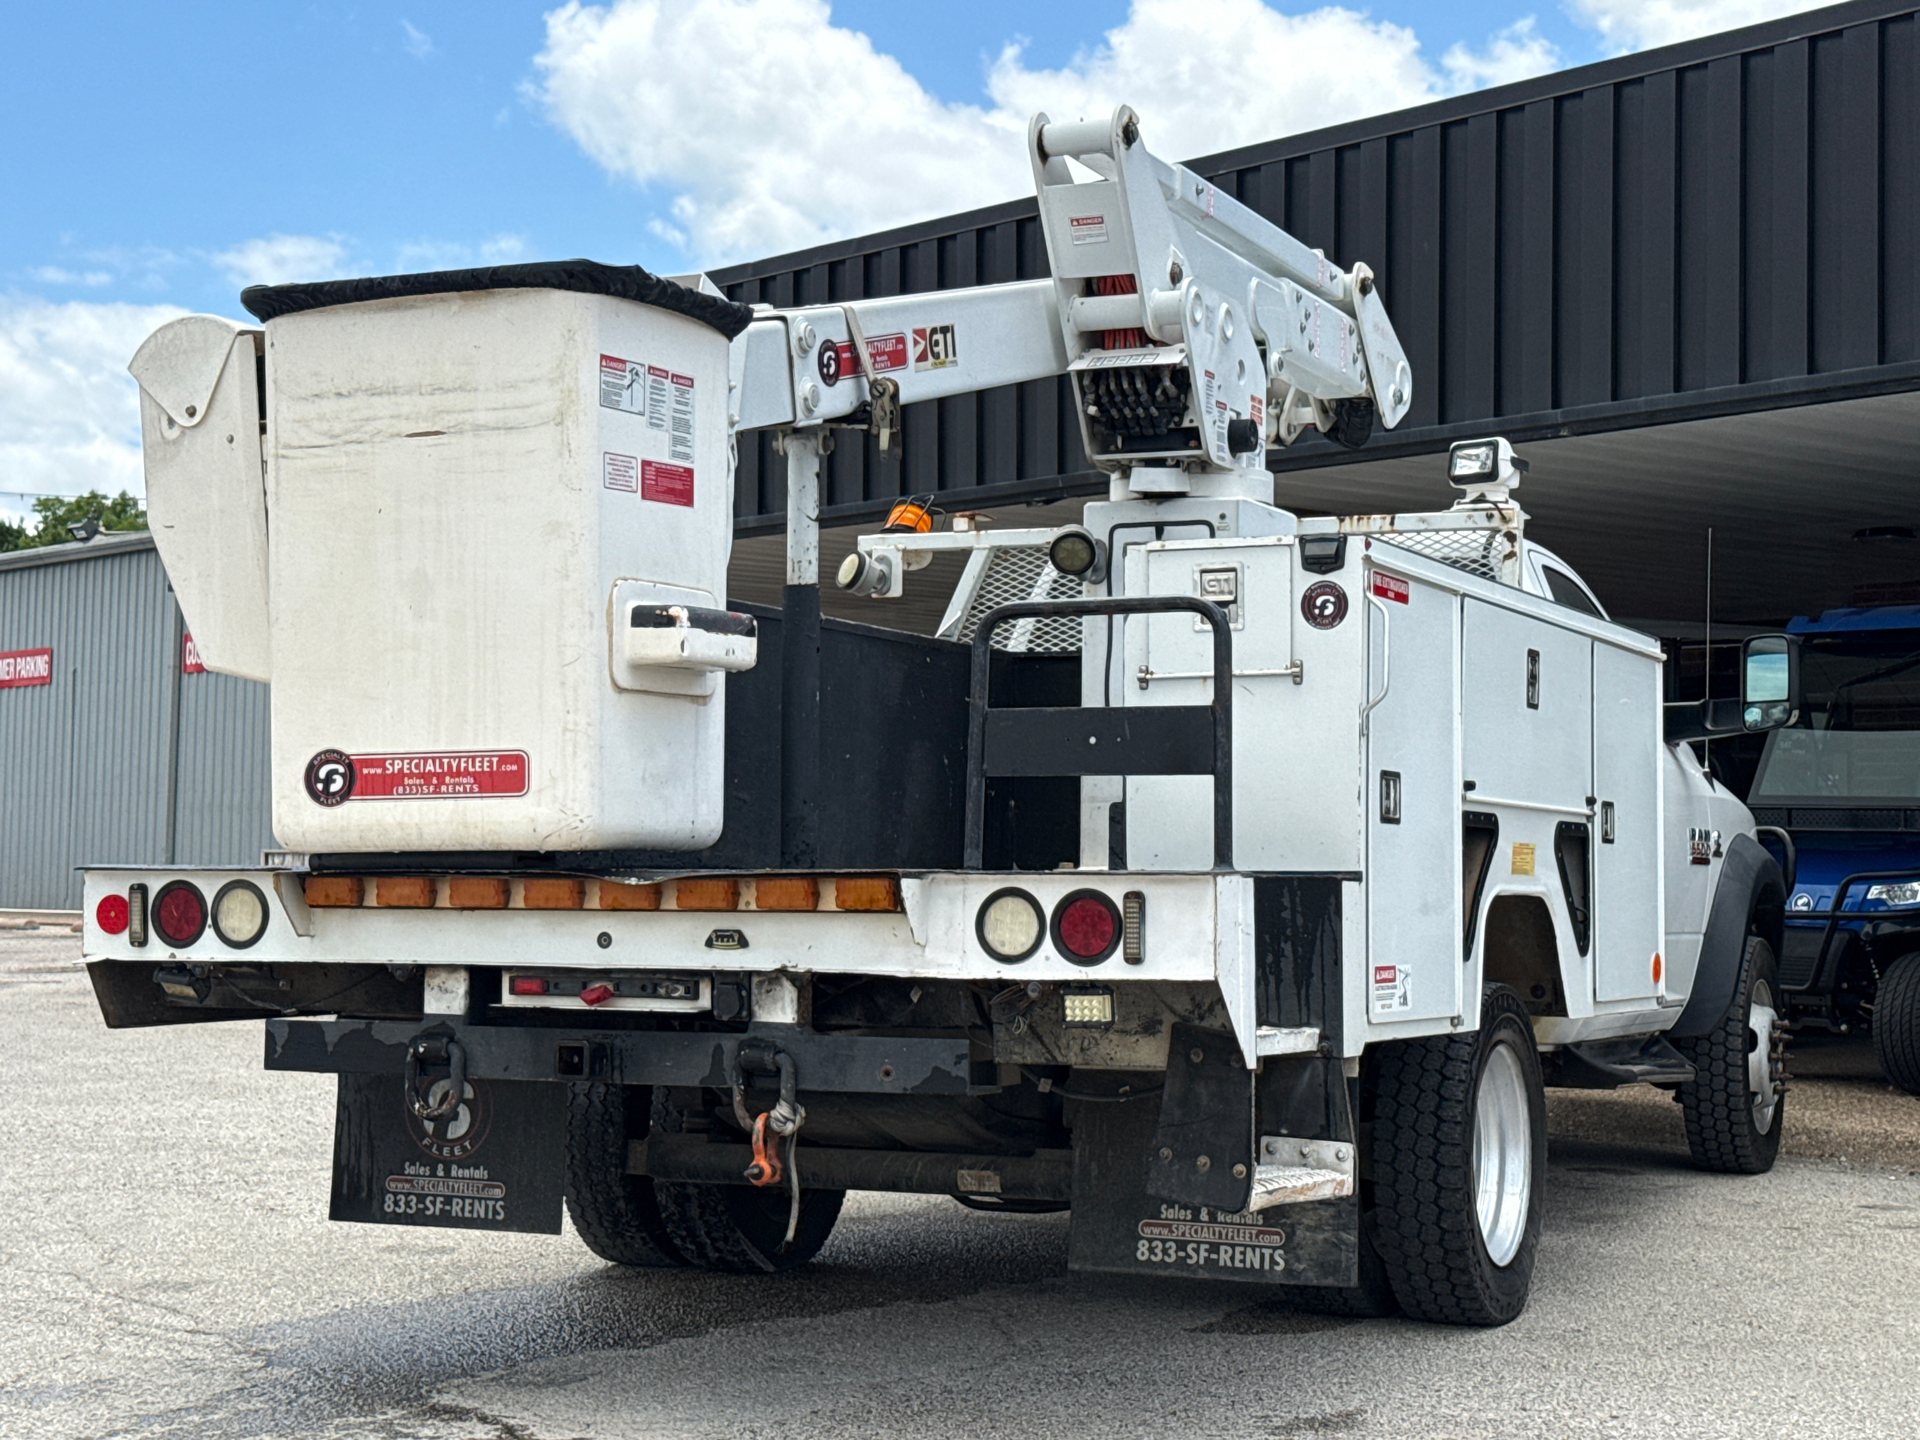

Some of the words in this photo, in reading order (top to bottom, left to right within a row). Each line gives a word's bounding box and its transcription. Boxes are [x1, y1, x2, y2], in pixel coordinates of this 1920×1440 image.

[1078, 217, 1102, 225] DANGER
[606, 359, 626, 372] DANGER
[676, 376, 693, 386] DANGER
[15, 654, 49, 679] PARKING
[312, 751, 350, 766] SPECIALTY
[403, 776, 425, 785] Sales
[431, 776, 438, 785] &
[444, 774, 475, 784] Rentals
[392, 784, 480, 796] (833)SF-RENTS
[319, 796, 341, 805] FLEET
[421, 1137, 472, 1157] FLEET
[404, 1161, 431, 1176] Sales
[436, 1163, 445, 1177] &
[450, 1164, 489, 1180] Rentals
[389, 1179, 503, 1197] www.SPECIALTYFLEET.com
[383, 1193, 505, 1220] 833-SF-RENTS
[1160, 1203, 1192, 1220] Sales
[1199, 1206, 1209, 1222] &
[1143, 1224, 1281, 1244] www.SPECIALTYFLEET.com
[1136, 1239, 1286, 1271] 833-SF-RENTS
